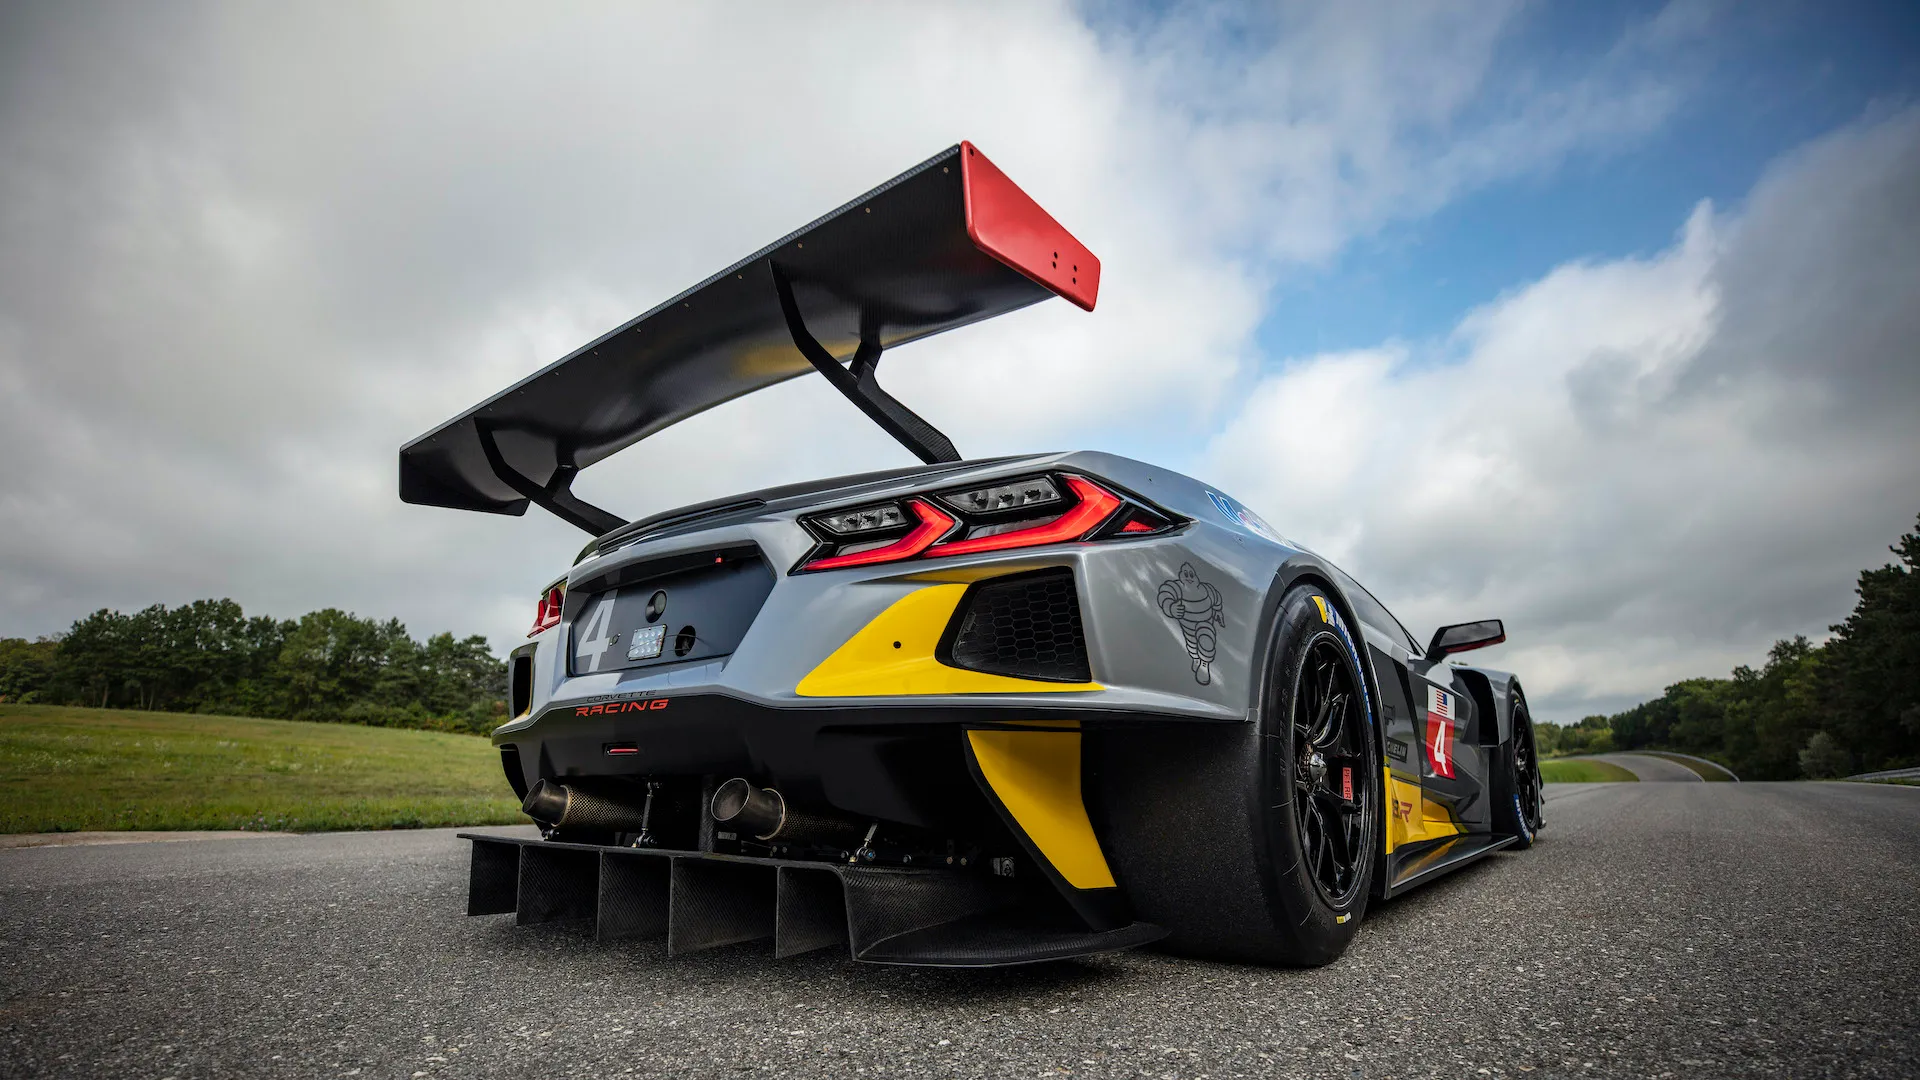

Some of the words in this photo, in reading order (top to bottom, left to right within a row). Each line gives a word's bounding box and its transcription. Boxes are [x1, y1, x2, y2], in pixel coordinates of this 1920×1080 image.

[576, 589, 618, 672] 4
[575, 699, 668, 717] RACING
[587, 690, 656, 703] CORVETTE
[1434, 721, 1448, 775] 4
